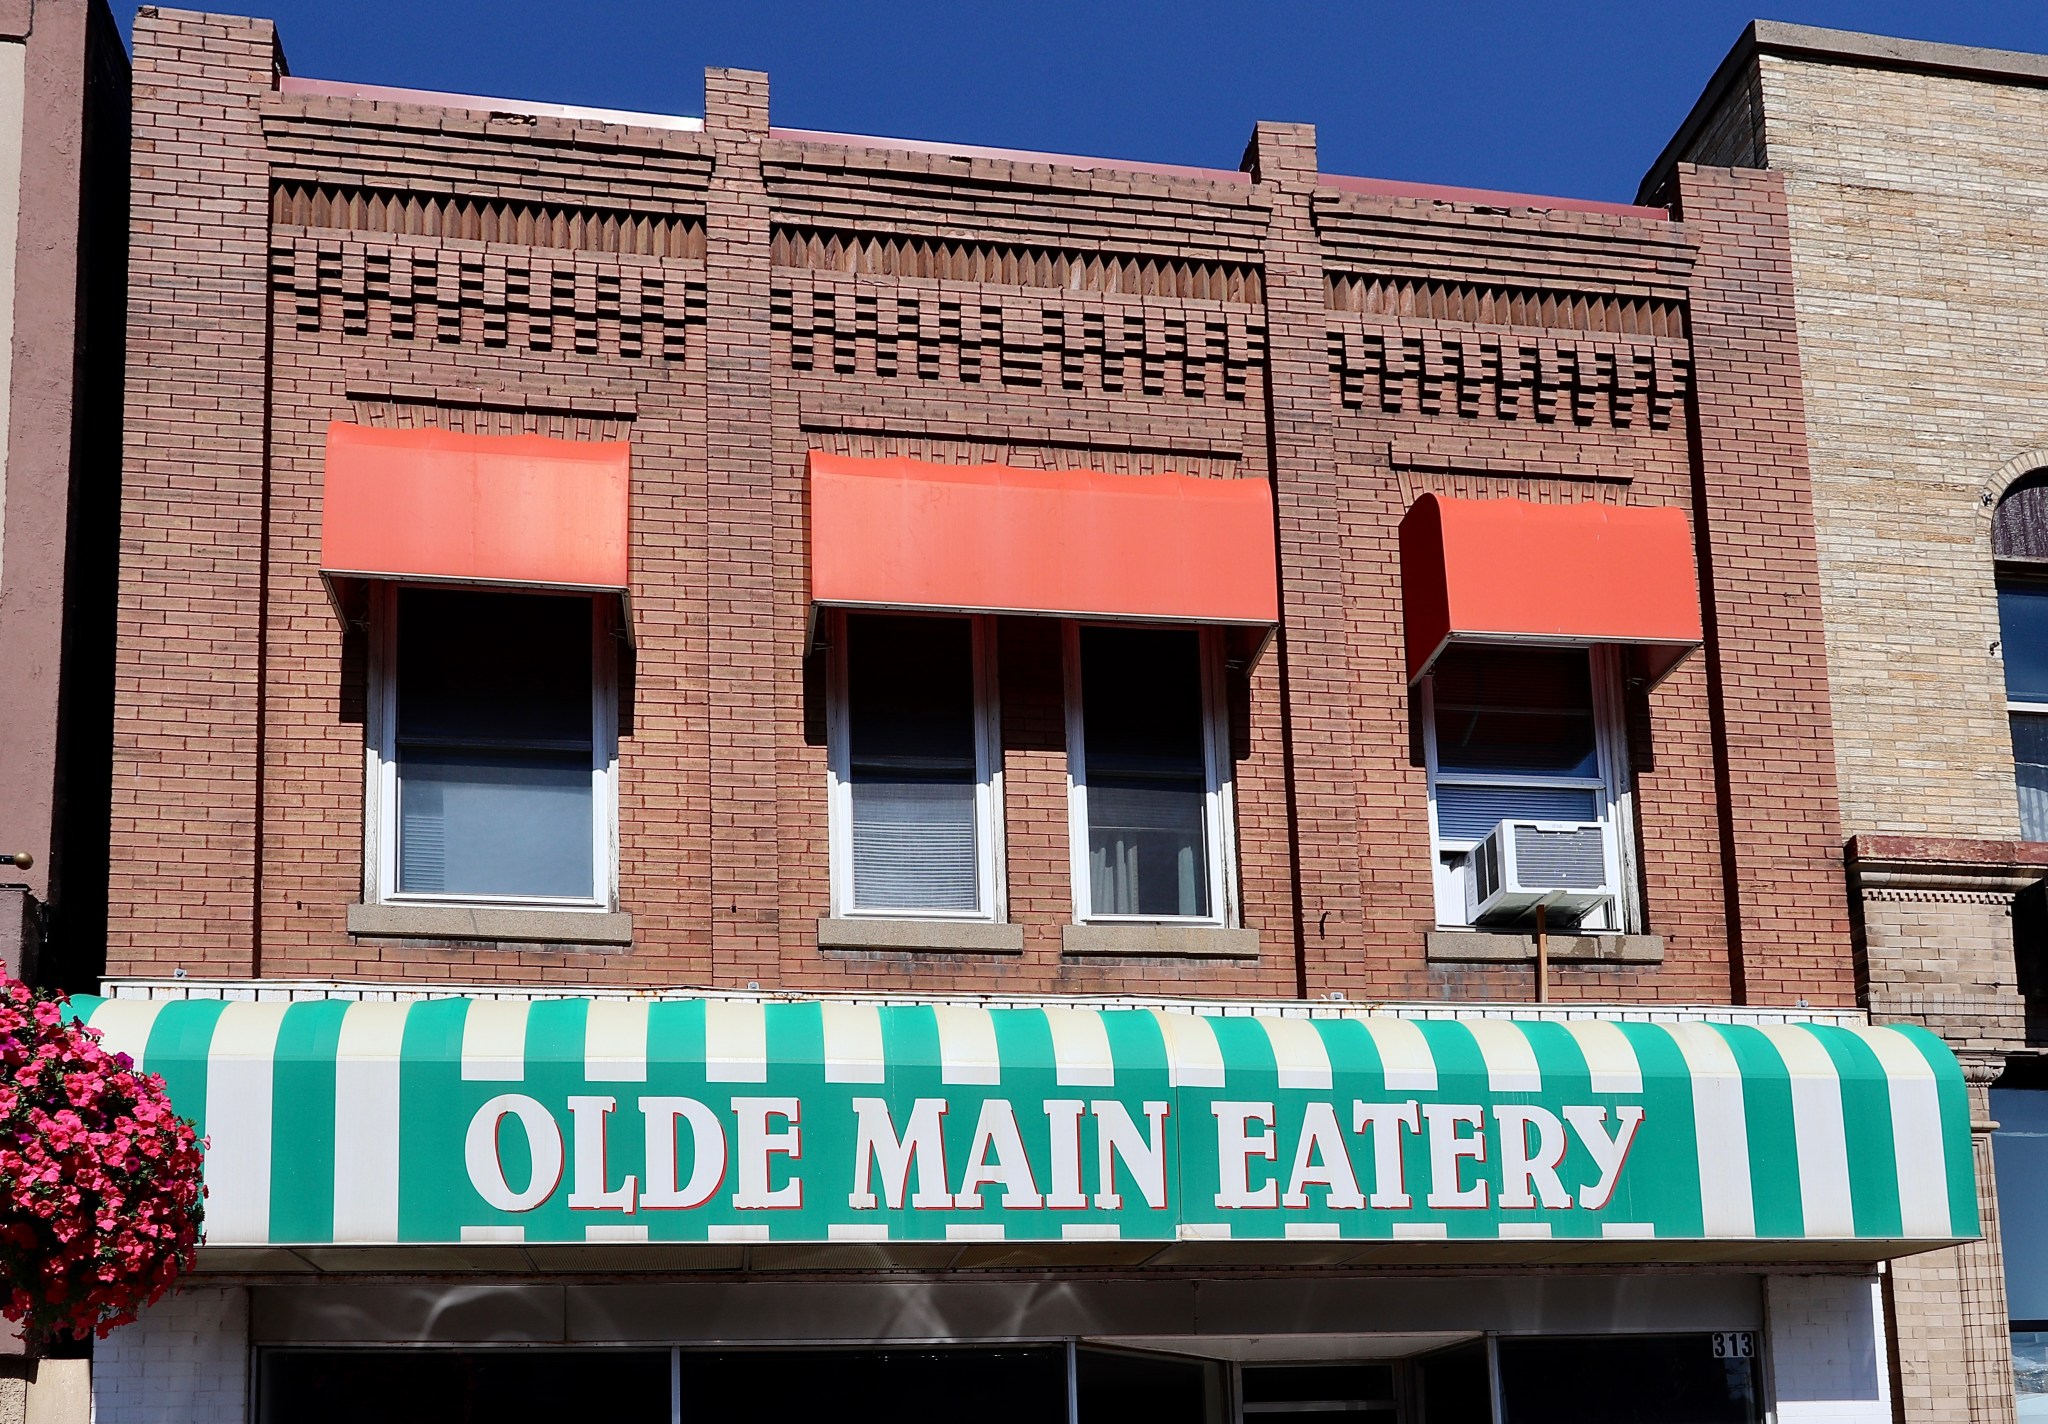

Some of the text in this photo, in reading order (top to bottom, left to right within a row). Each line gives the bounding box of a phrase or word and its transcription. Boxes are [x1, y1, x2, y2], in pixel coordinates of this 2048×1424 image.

[464, 1093, 1646, 1214] OLDE MAIN EATERY
[1713, 1333, 1753, 1357] 313
